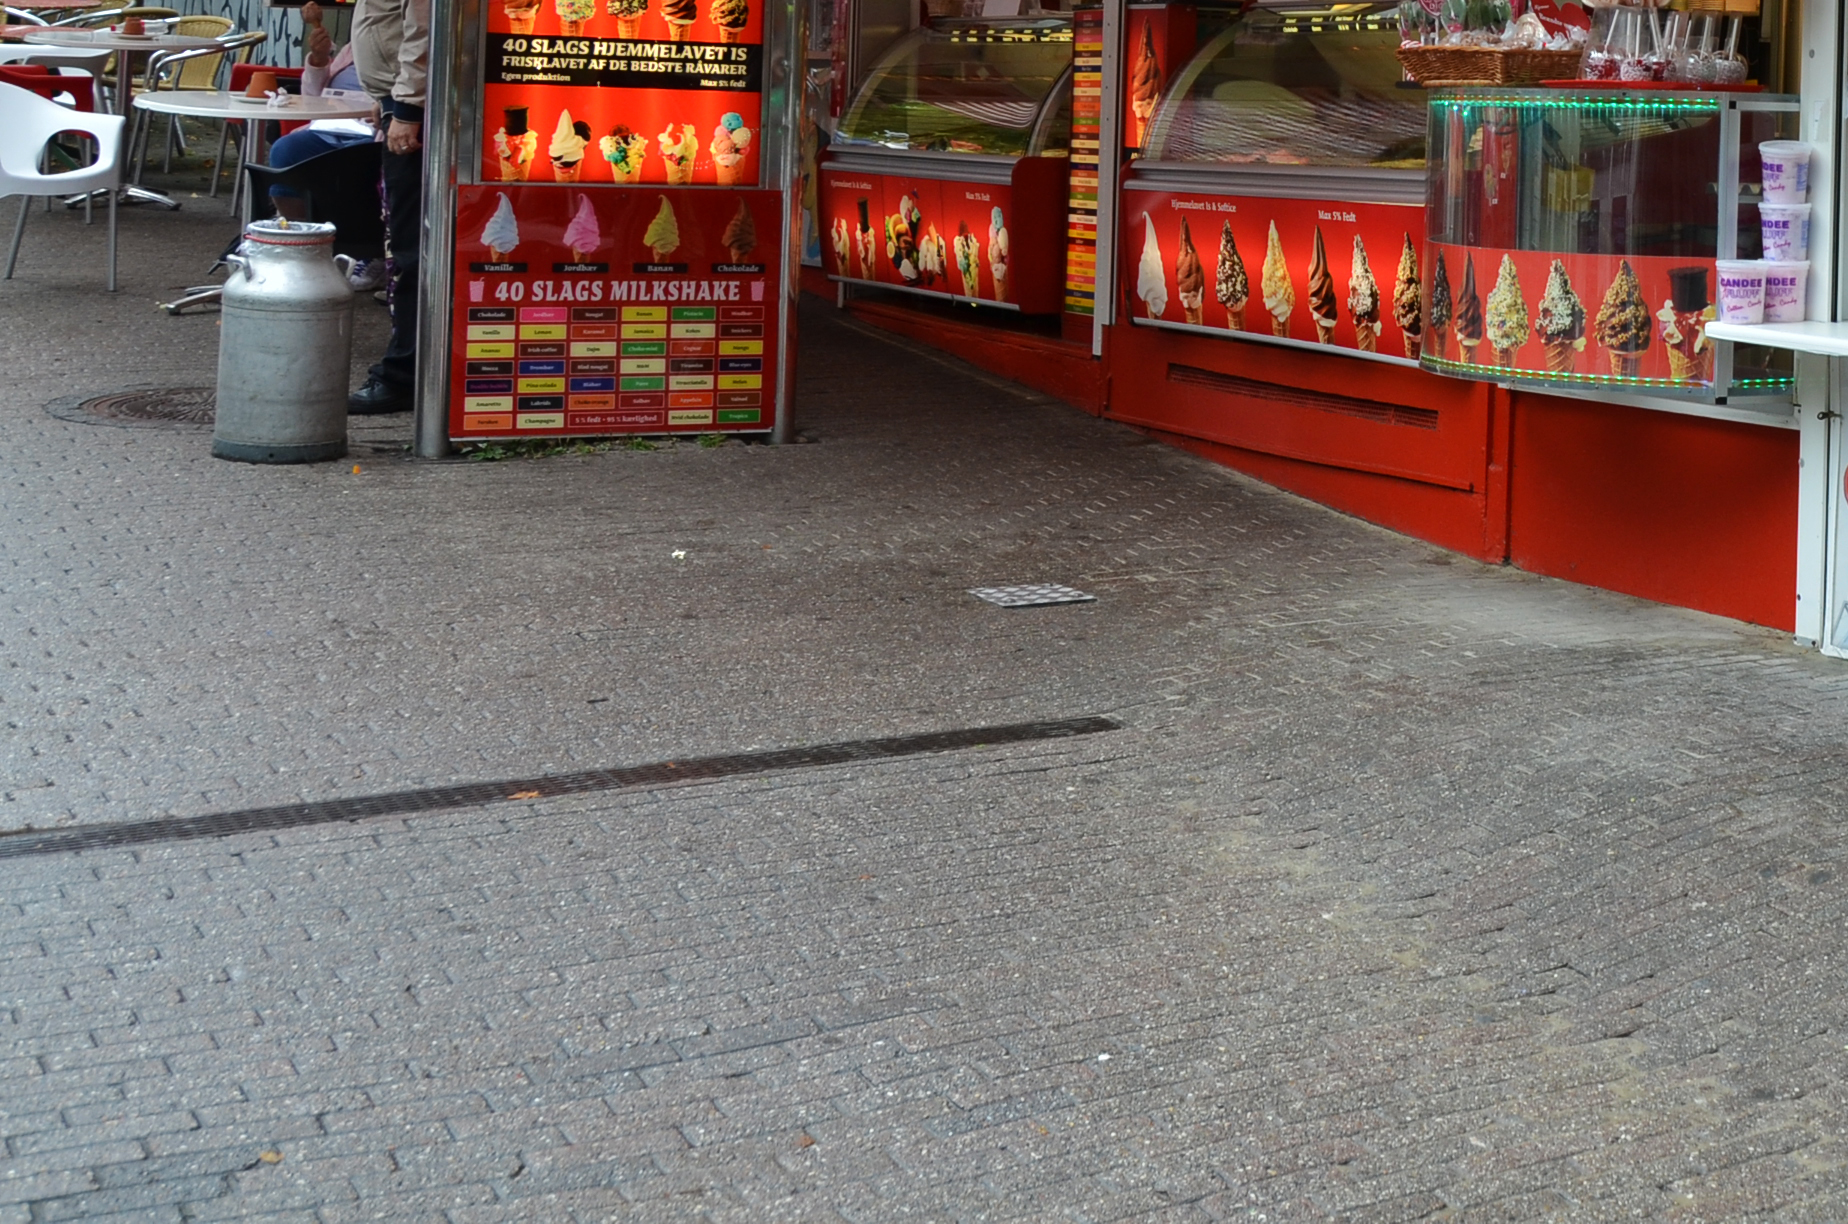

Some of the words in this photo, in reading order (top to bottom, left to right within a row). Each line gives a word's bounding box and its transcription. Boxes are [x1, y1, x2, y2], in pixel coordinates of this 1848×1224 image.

[502, 38, 528, 54] 40
[530, 38, 590, 56] SLAGS
[592, 40, 727, 62] HJEMMELAVET
[730, 46, 748, 62] IS
[501, 55, 587, 71] FRISKLAVET
[588, 58, 607, 71] AF
[608, 58, 629, 72] DE
[630, 59, 684, 74] BEDSTE
[684, 59, 748, 77] RÅVARER
[522, 72, 571, 84] produktion
[484, 262, 515, 273] Vanille
[562, 263, 599, 274] Jordbær
[646, 263, 674, 273] Banan
[716, 263, 760, 274] Chokolade
[1720, 278, 1763, 289] CANDEE
[494, 281, 525, 303] 40
[531, 280, 604, 303] SLAGS
[608, 279, 741, 303] MILKSHAKE
